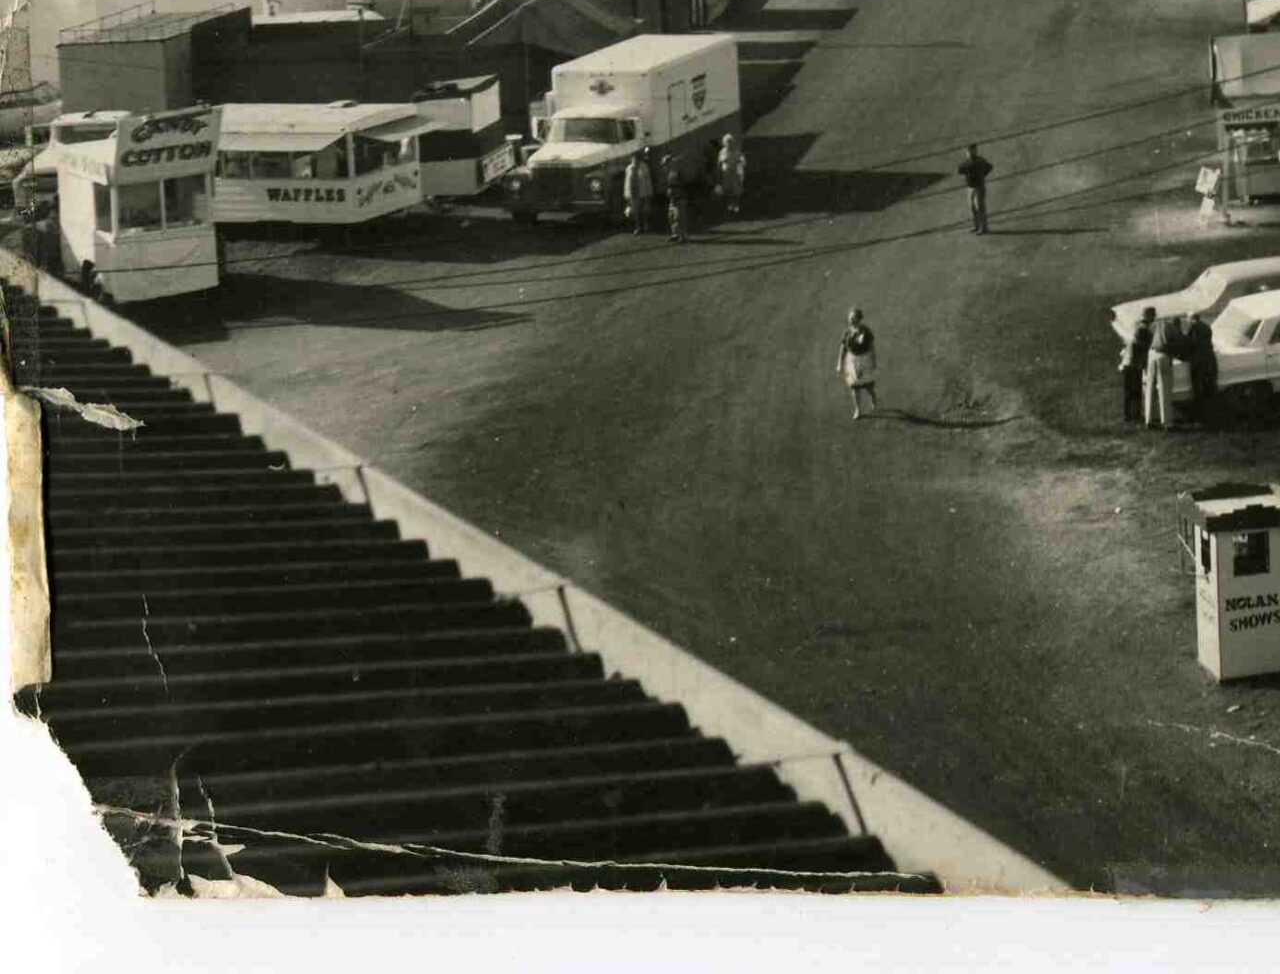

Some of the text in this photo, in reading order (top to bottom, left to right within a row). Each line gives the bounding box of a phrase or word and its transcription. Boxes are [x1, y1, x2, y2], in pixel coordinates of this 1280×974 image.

[131, 115, 208, 143] CANDY
[121, 140, 212, 167] COTTON
[266, 188, 346, 202] WAFFLES
[1225, 593, 1279, 612] NOLAN
